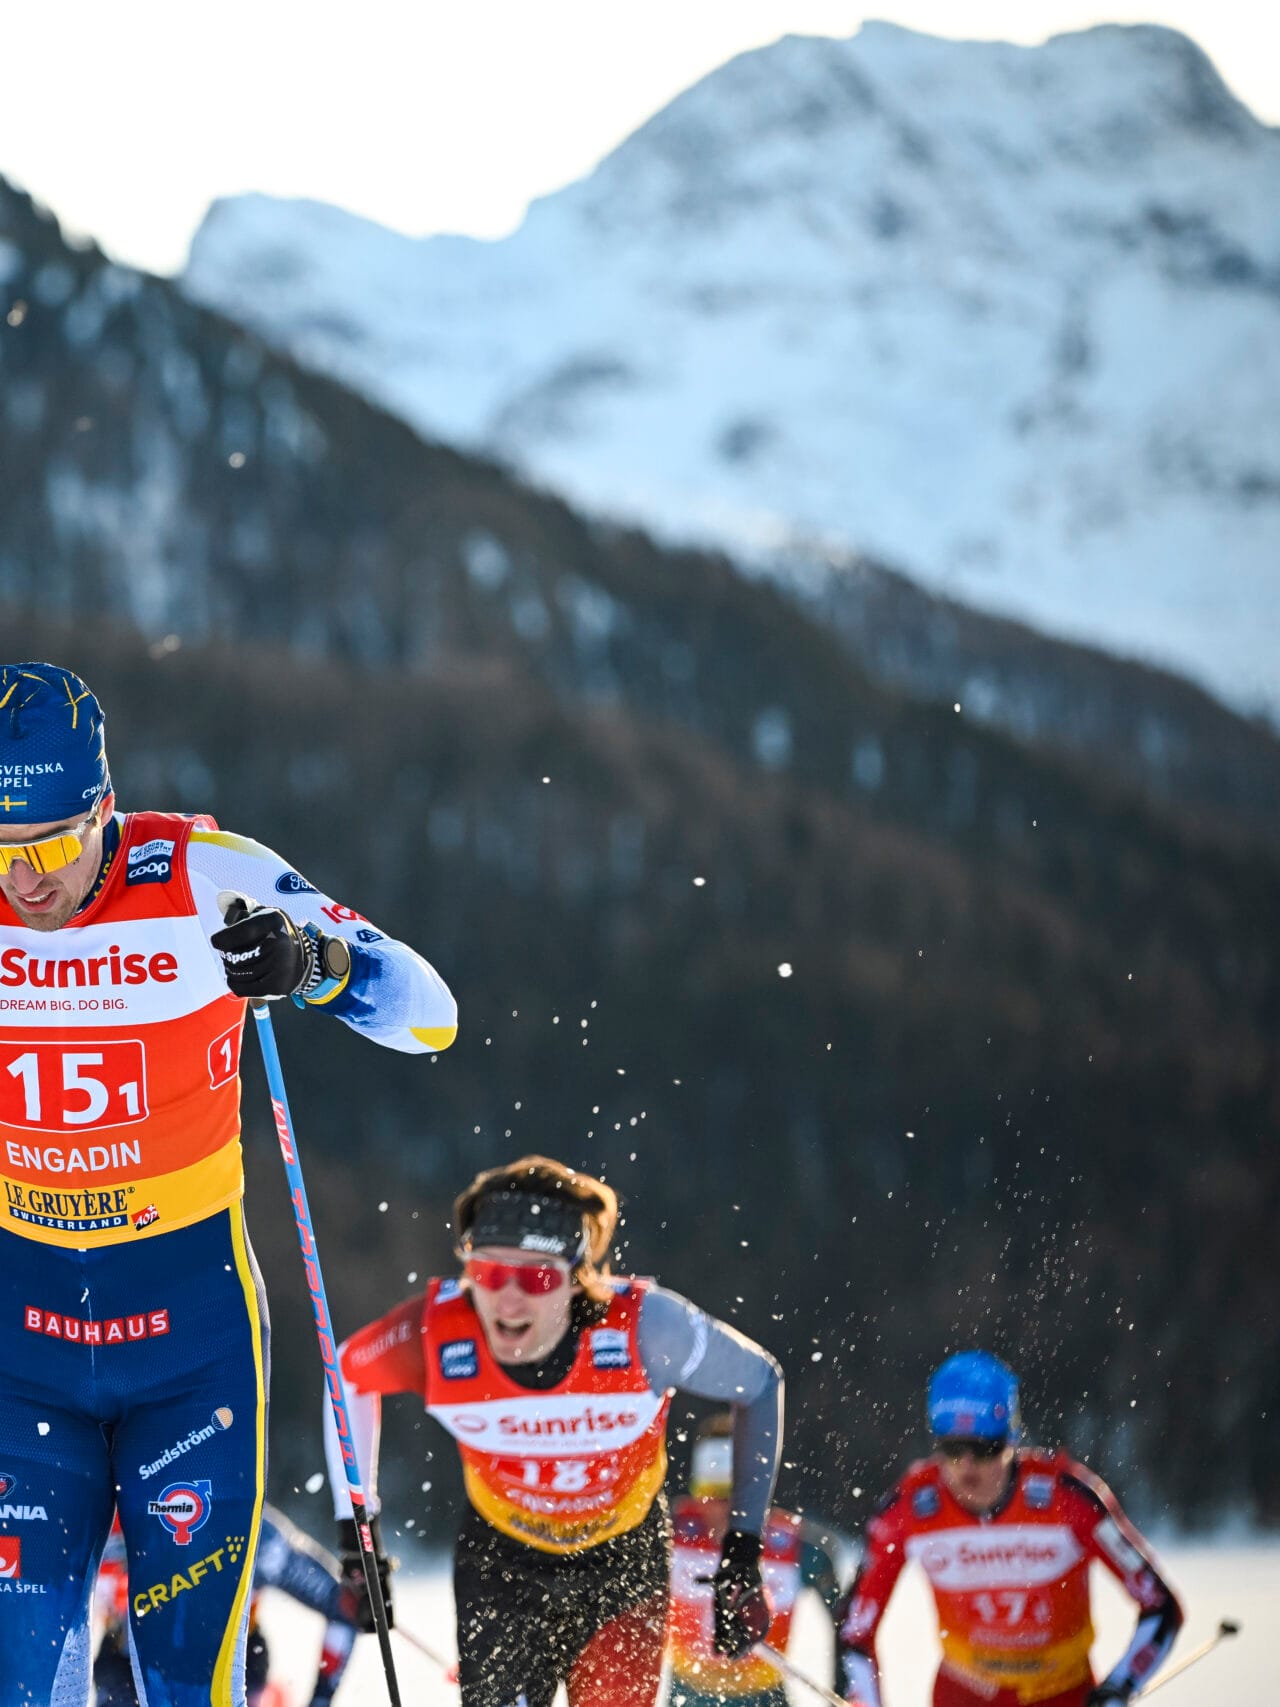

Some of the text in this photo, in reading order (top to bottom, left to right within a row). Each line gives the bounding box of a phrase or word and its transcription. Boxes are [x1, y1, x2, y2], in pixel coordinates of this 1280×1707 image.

[128, 861, 169, 879] coop
[0, 998, 128, 1011] DREAM BIG. DO BIG.
[5, 1139, 142, 1173] ENGADIN
[4, 1181, 26, 1208] LE
[12, 1208, 122, 1230] SWITZERLAND
[27, 1309, 167, 1342] BAUHAUS
[498, 1407, 639, 1437] Sunrise
[138, 1424, 216, 1480] Sundström
[149, 1502, 194, 1514] Thermia
[16, 1583, 47, 1594] SPEL
[133, 1548, 225, 1618] CRAFT
